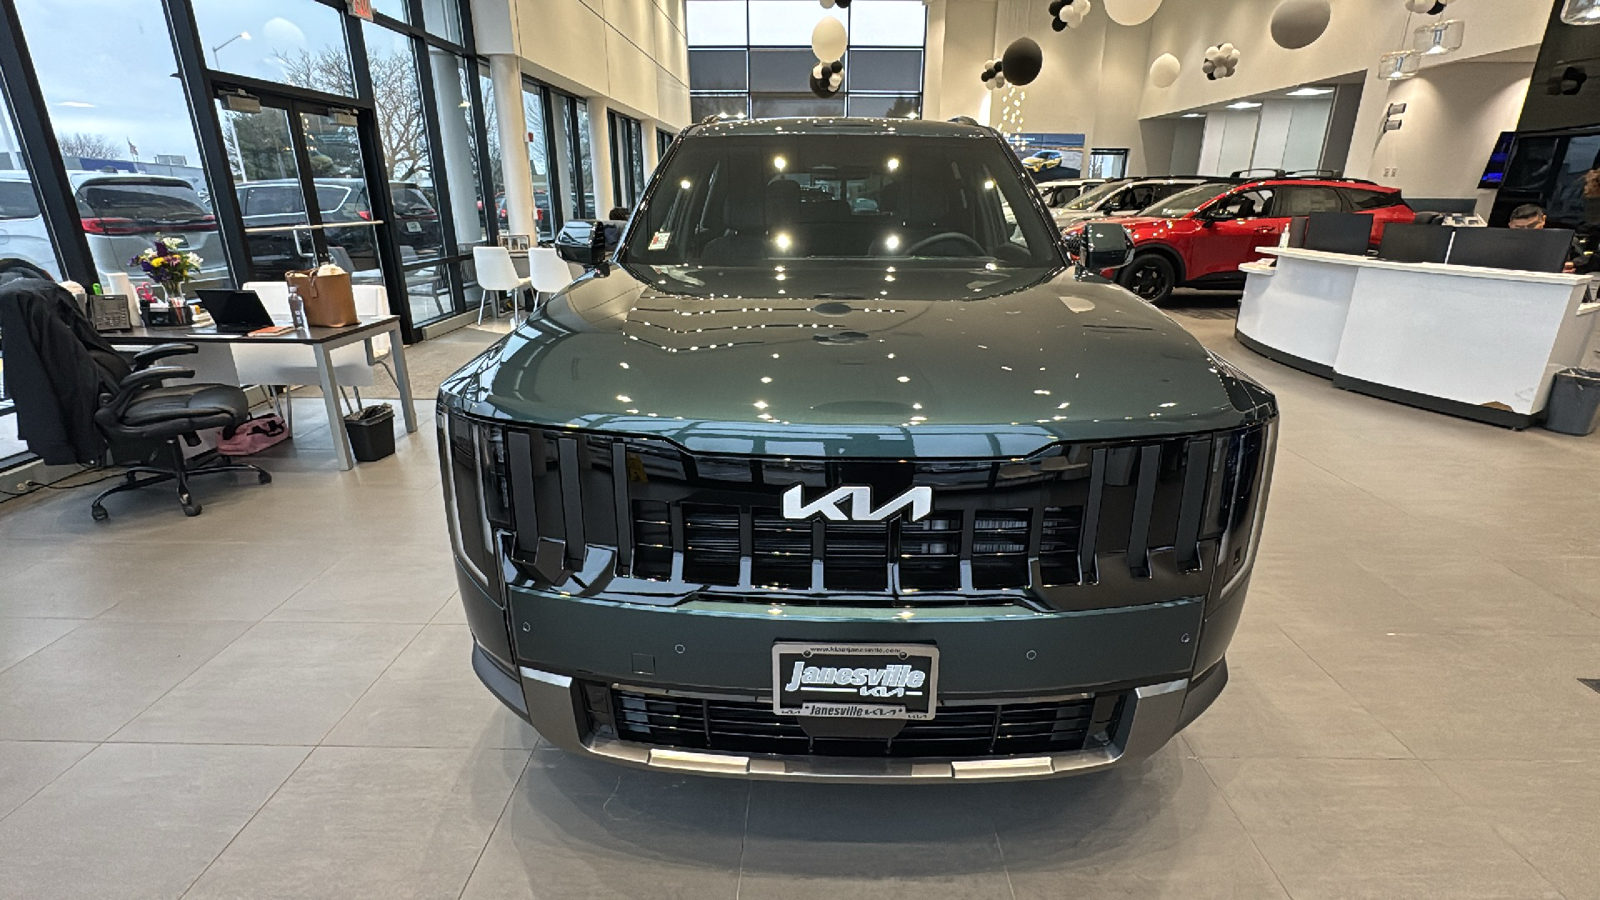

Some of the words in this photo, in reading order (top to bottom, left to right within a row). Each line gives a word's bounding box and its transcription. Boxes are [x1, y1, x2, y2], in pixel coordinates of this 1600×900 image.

[783, 484, 932, 522] KIA
[785, 661, 926, 692] Janesville
[860, 686, 904, 698] KIA
[810, 705, 863, 716] Janesville
[864, 708, 897, 716] KIA
